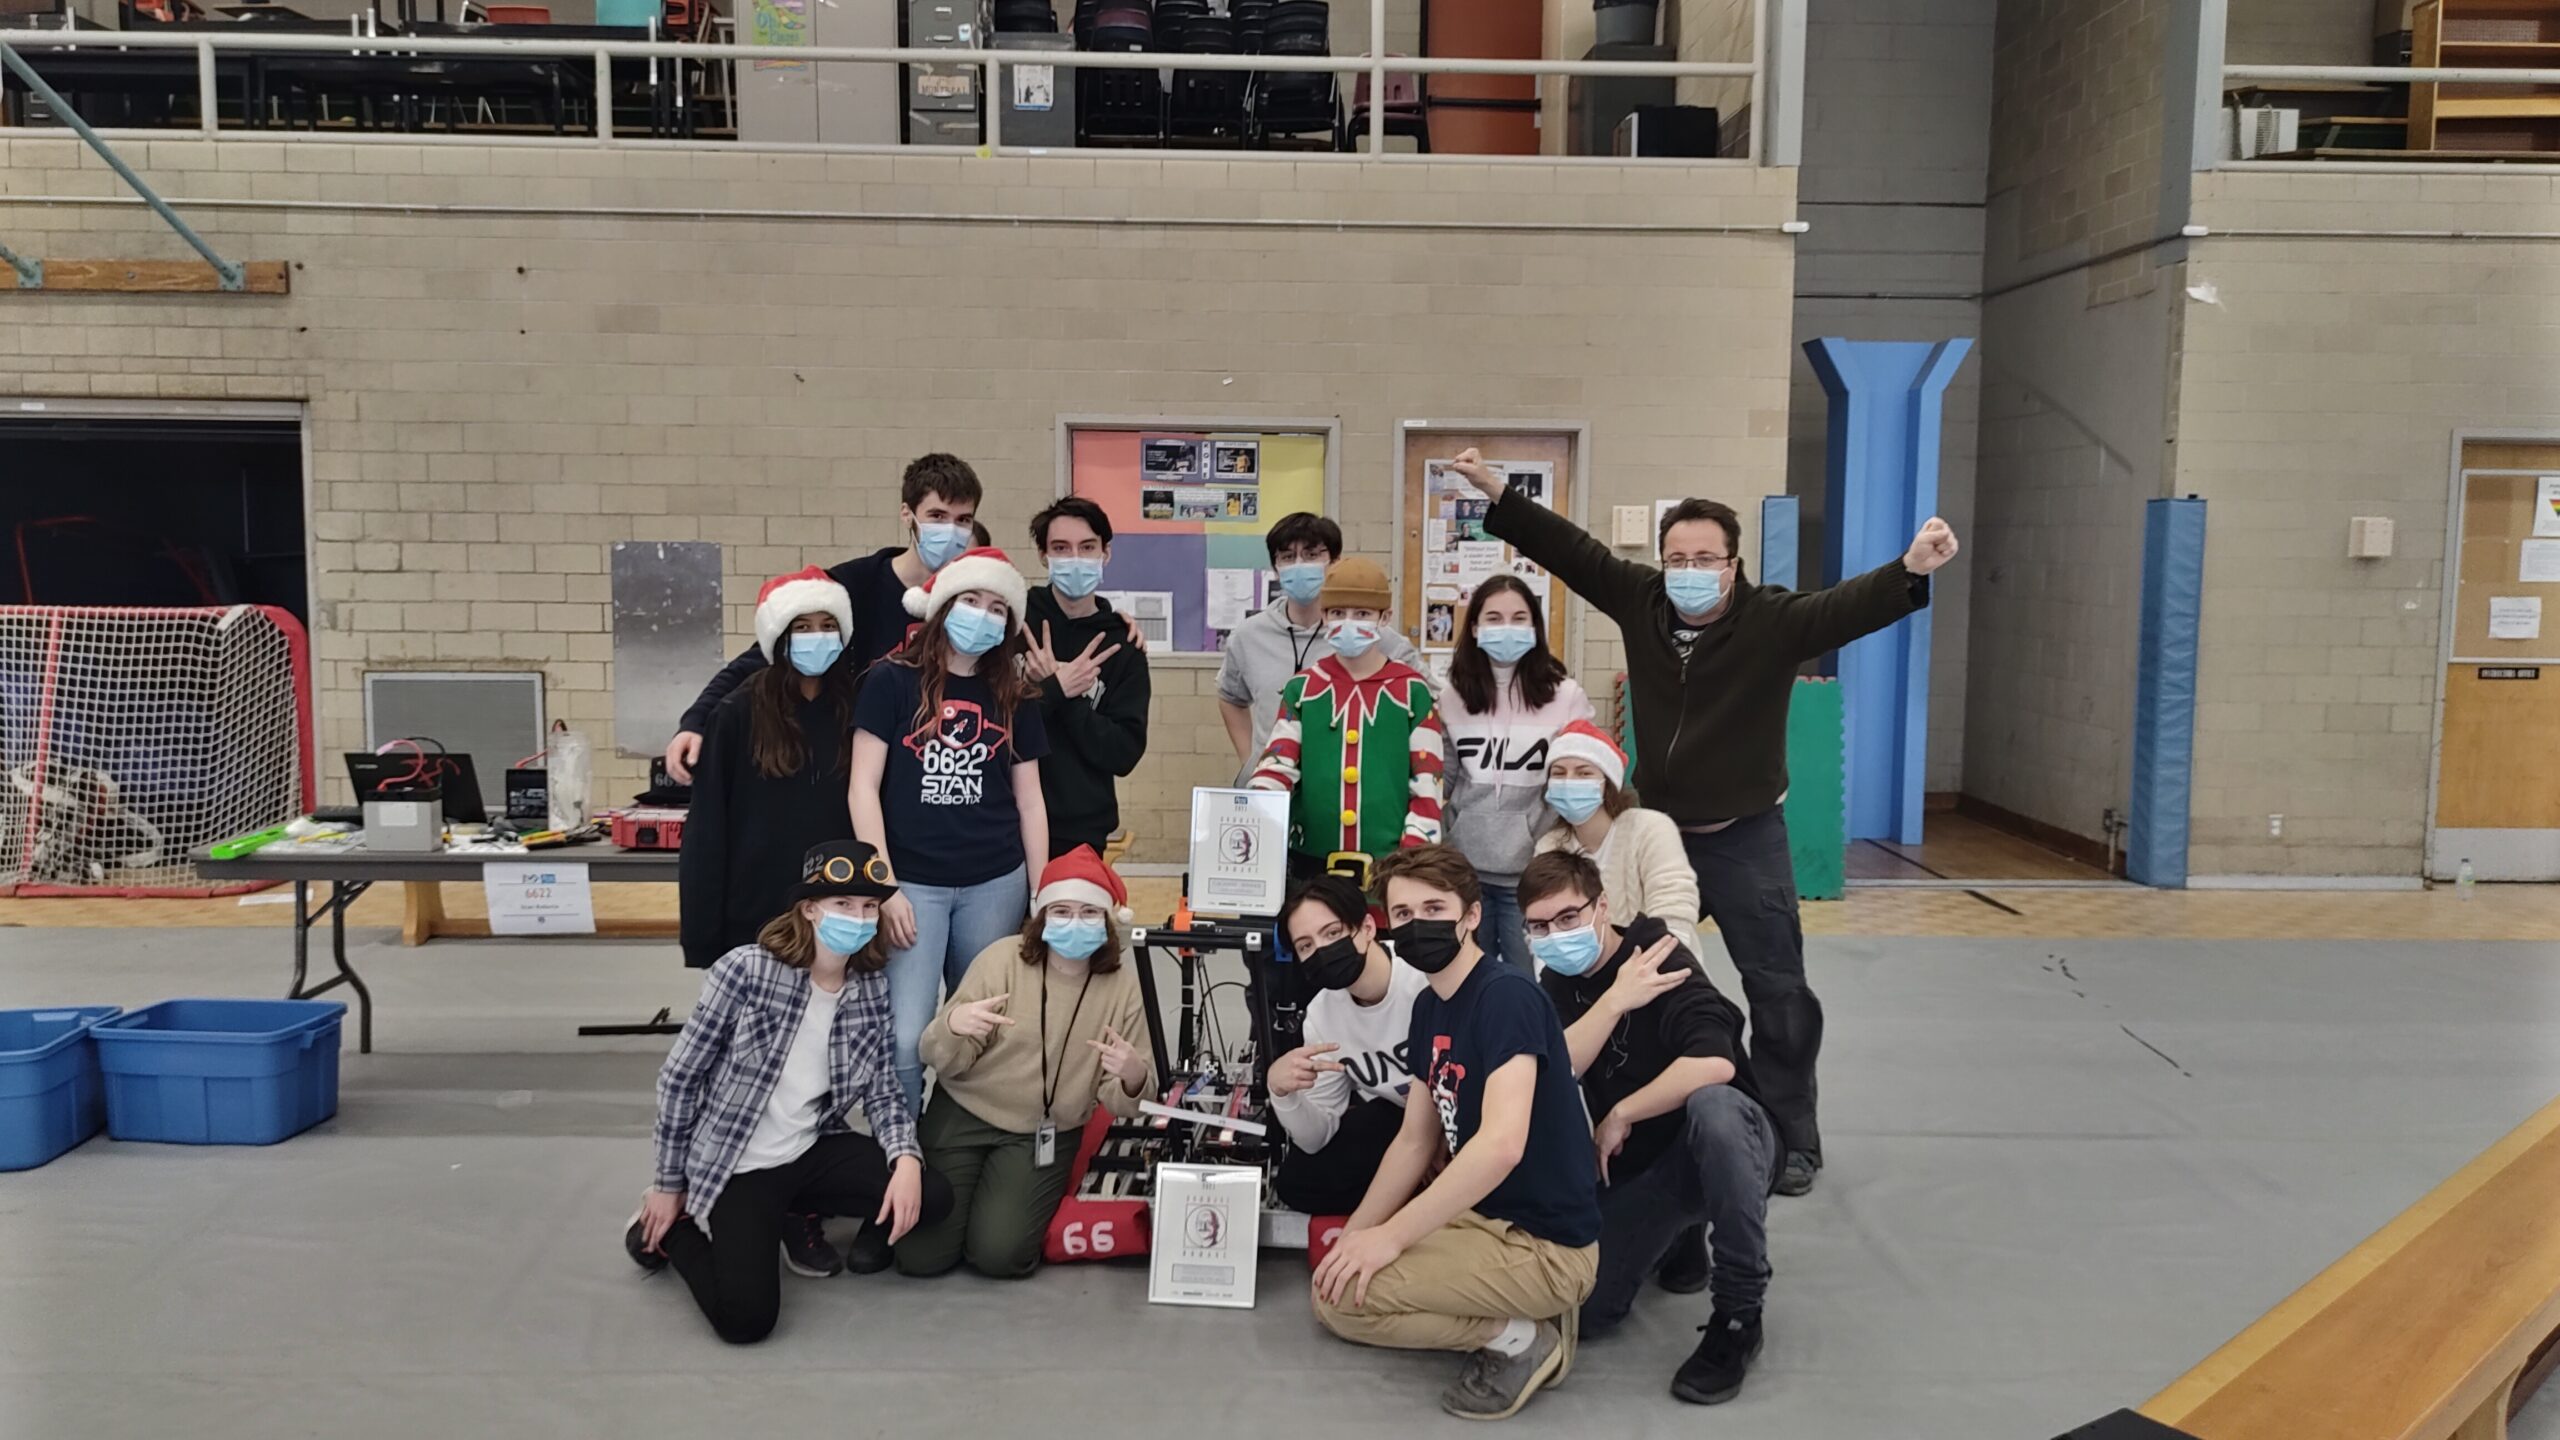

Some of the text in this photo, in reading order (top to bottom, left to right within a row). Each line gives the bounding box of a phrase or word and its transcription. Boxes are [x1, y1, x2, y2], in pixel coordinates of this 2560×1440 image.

[923, 739, 988, 775] 6622
[1457, 737, 1549, 770] FILA
[921, 774, 983, 796] STAN
[1063, 1221, 1115, 1255] 66
